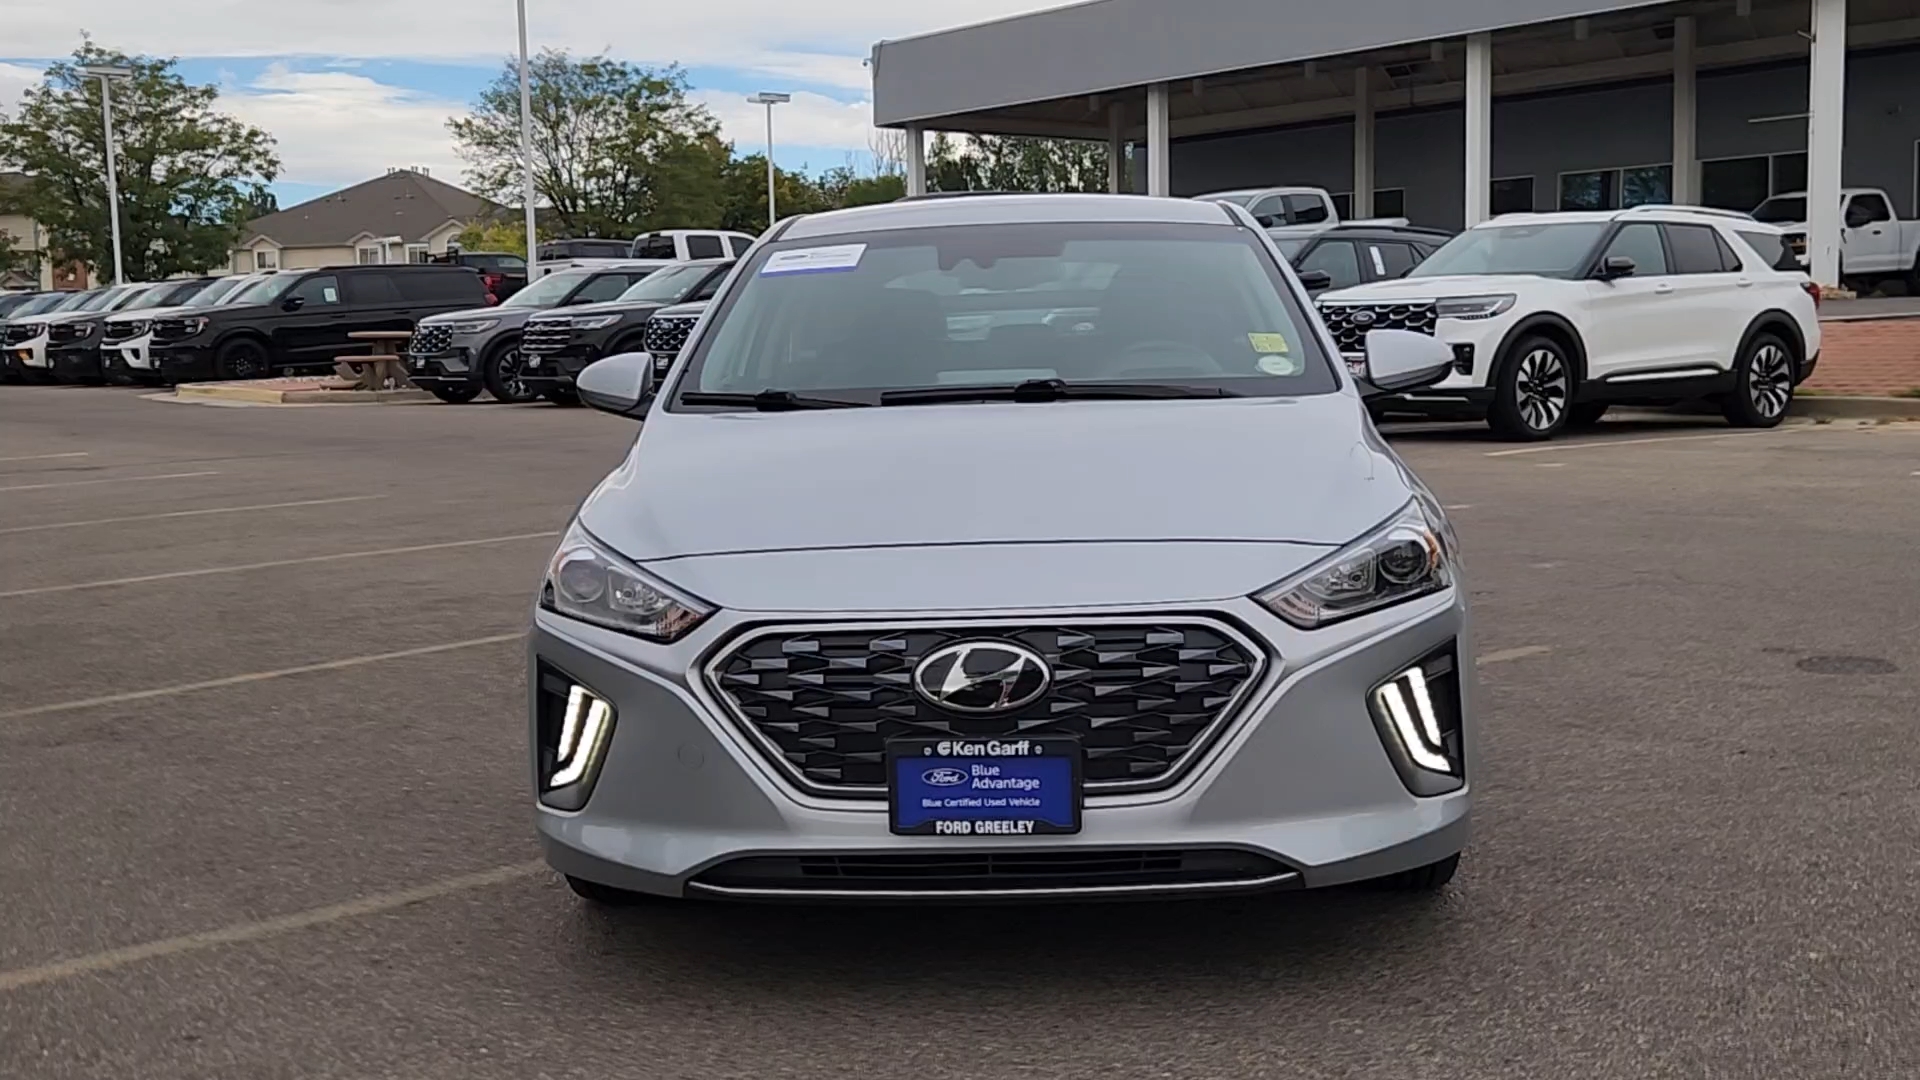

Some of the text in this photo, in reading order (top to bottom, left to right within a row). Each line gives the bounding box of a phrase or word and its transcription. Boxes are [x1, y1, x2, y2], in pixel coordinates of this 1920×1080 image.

[953, 740, 1030, 756] Ken Garff
[971, 764, 1000, 776] Blue
[971, 777, 1040, 791] Advantage
[922, 798, 1040, 807] Blue Certified Used Vehicle
[935, 820, 1034, 834] FORD GREELEY
